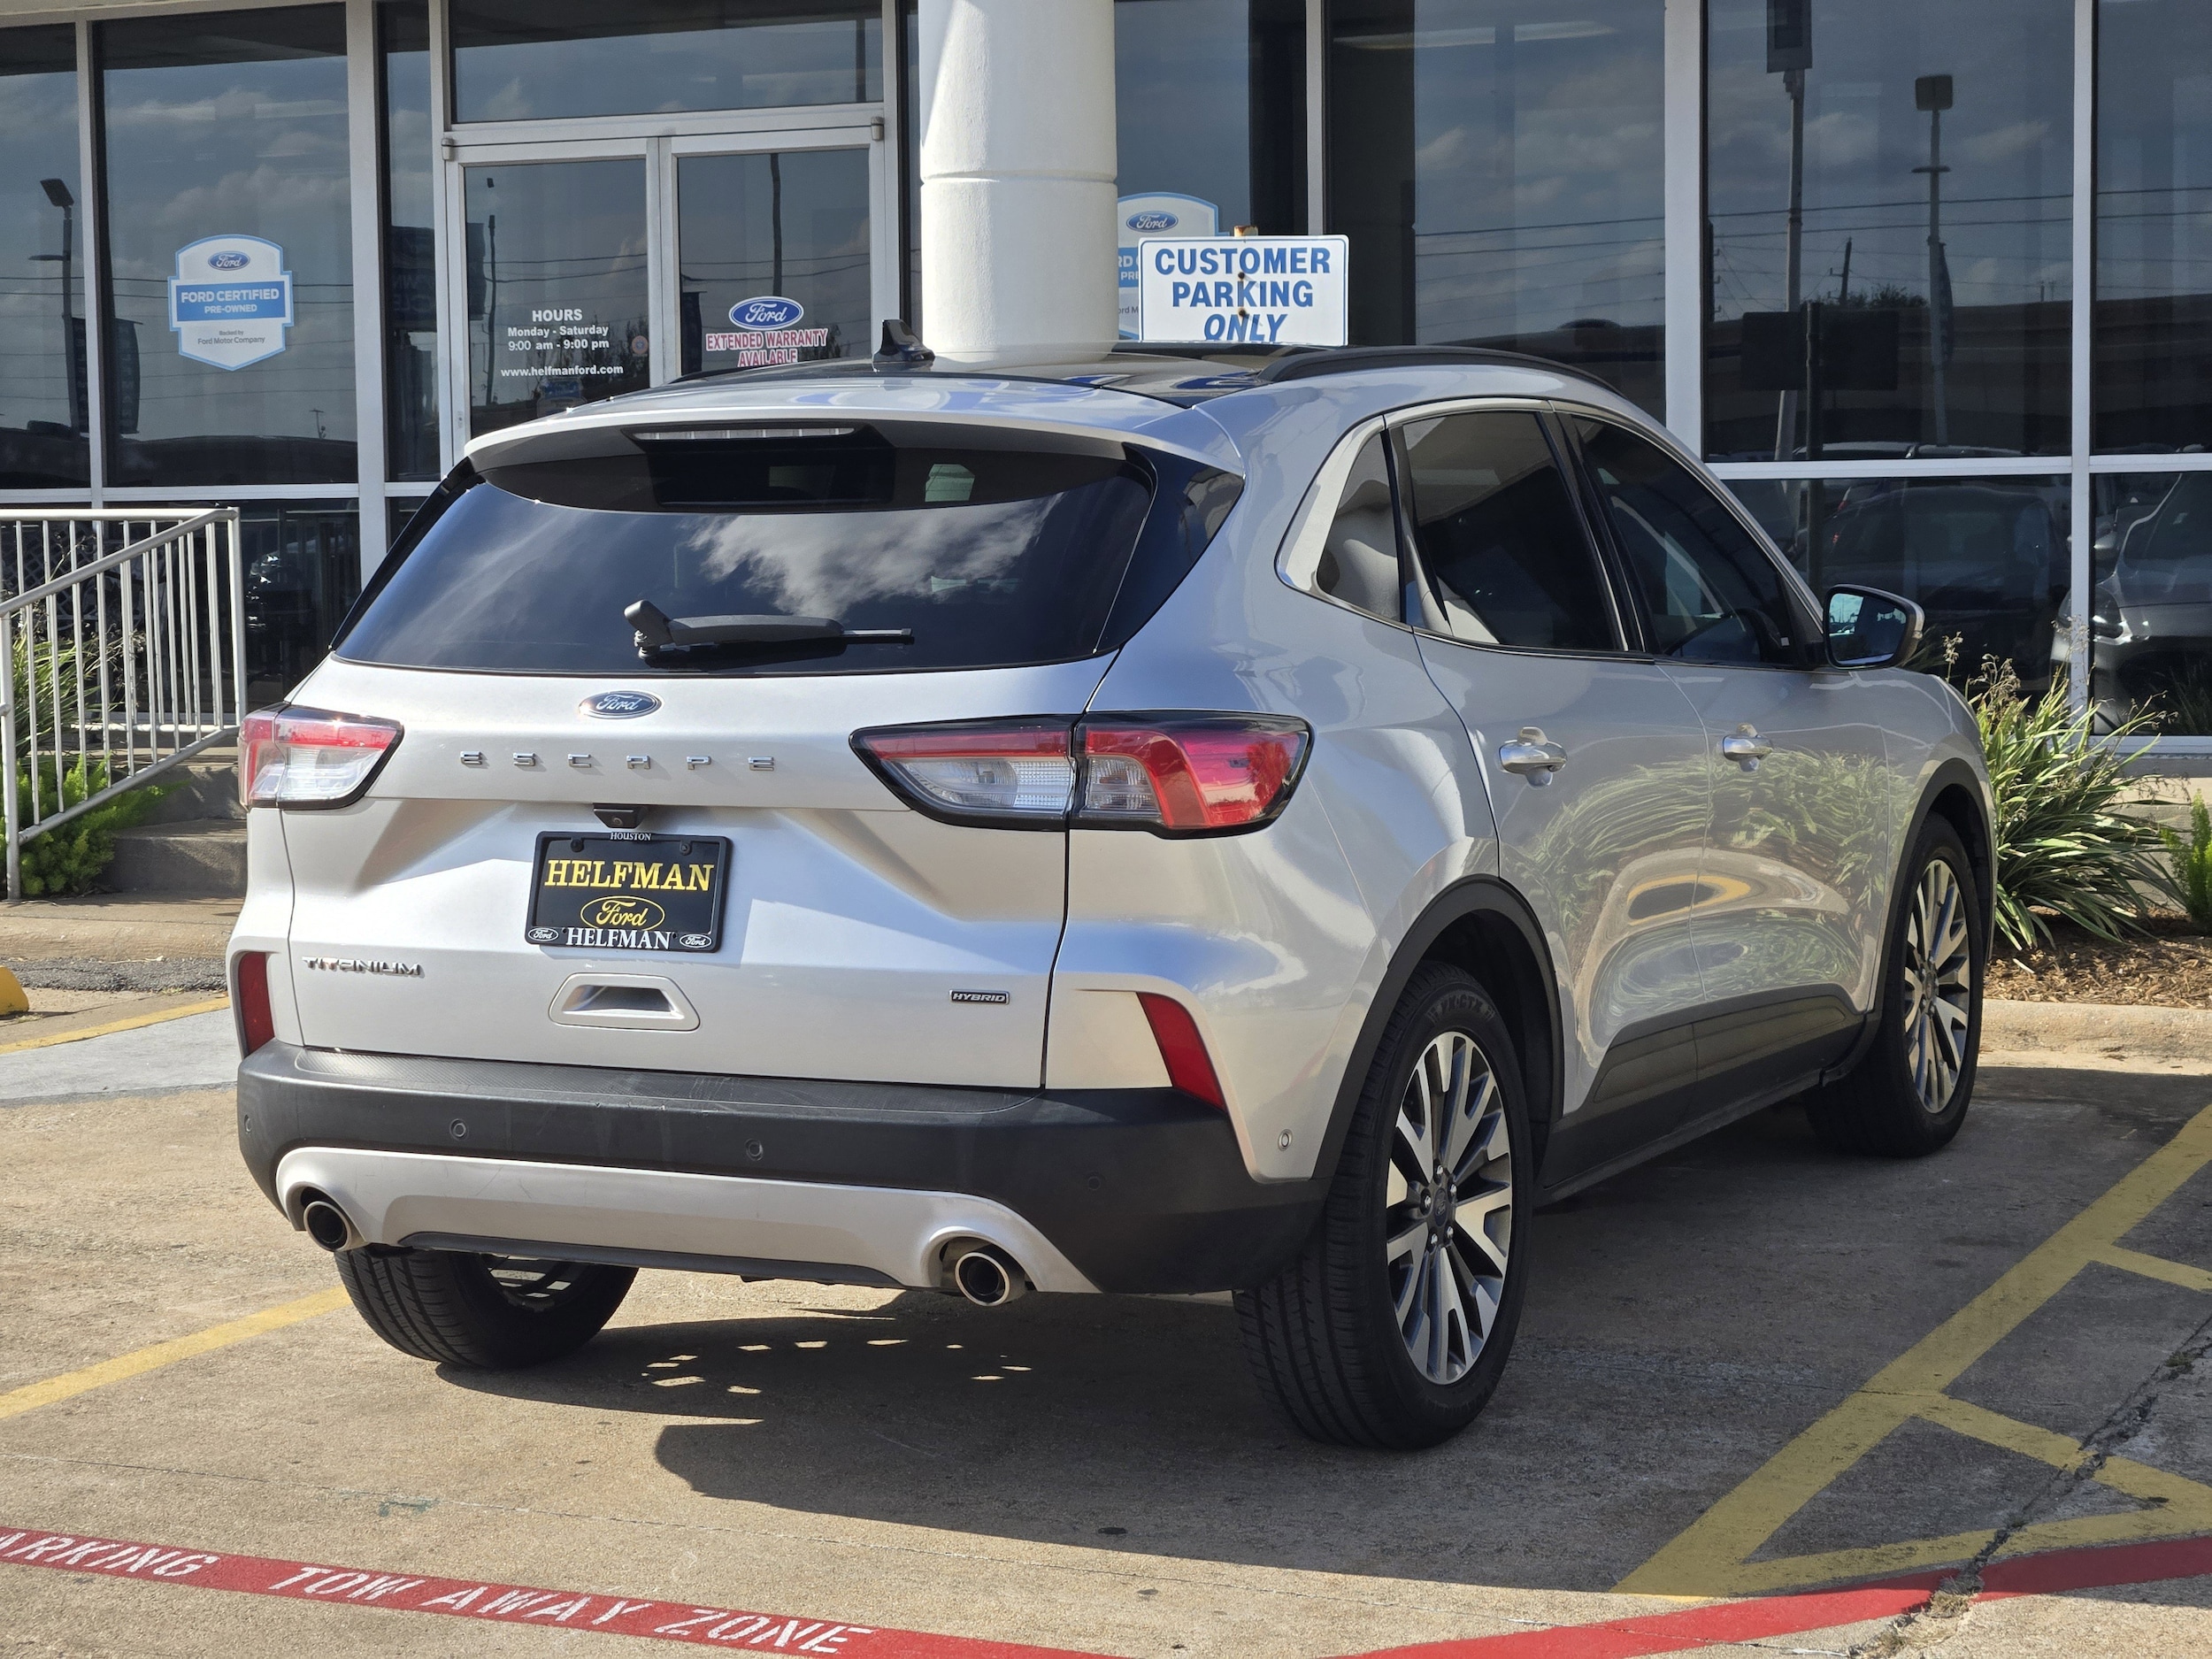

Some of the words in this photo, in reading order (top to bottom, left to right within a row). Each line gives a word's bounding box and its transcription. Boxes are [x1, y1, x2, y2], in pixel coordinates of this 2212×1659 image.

[1136, 213, 1168, 230] Ford
[216, 254, 242, 267] Ford
[1155, 247, 1331, 274] CUSTOMER
[181, 291, 213, 303] FORD
[217, 288, 280, 302] CERTIFIED
[1172, 280, 1313, 307] PARKING
[204, 303, 257, 314] PRE-OWNED
[532, 309, 583, 322] HOURS
[745, 303, 788, 323] Ford
[508, 326, 549, 338] Monday
[559, 325, 609, 336] Saturday
[1204, 313, 1287, 342] ONLY
[509, 341, 532, 351] 9:00
[564, 339, 588, 349] 9:00
[592, 340, 610, 350] pm
[706, 333, 764, 351] EXTENDED
[765, 328, 828, 349] WARRANTY
[737, 348, 798, 367] AVAILABLE
[501, 365, 624, 377] www.helfmanford.com
[595, 694, 641, 710] Ford
[459, 750, 775, 772] ESCAPE
[610, 832, 652, 841] HOUSTON
[544, 859, 715, 892] HELFMAN
[595, 899, 649, 927] Ford
[531, 929, 553, 940] Ford
[565, 926, 672, 950] HELFMAN
[682, 935, 707, 947] Ford
[302, 956, 421, 976] TITANIUM
[952, 993, 1006, 1002] HYBRID
[0, 1532, 220, 1577] RKING
[268, 1567, 426, 1601] TOW
[419, 1586, 653, 1625] AWAY
[653, 1609, 875, 1654] ZONE
